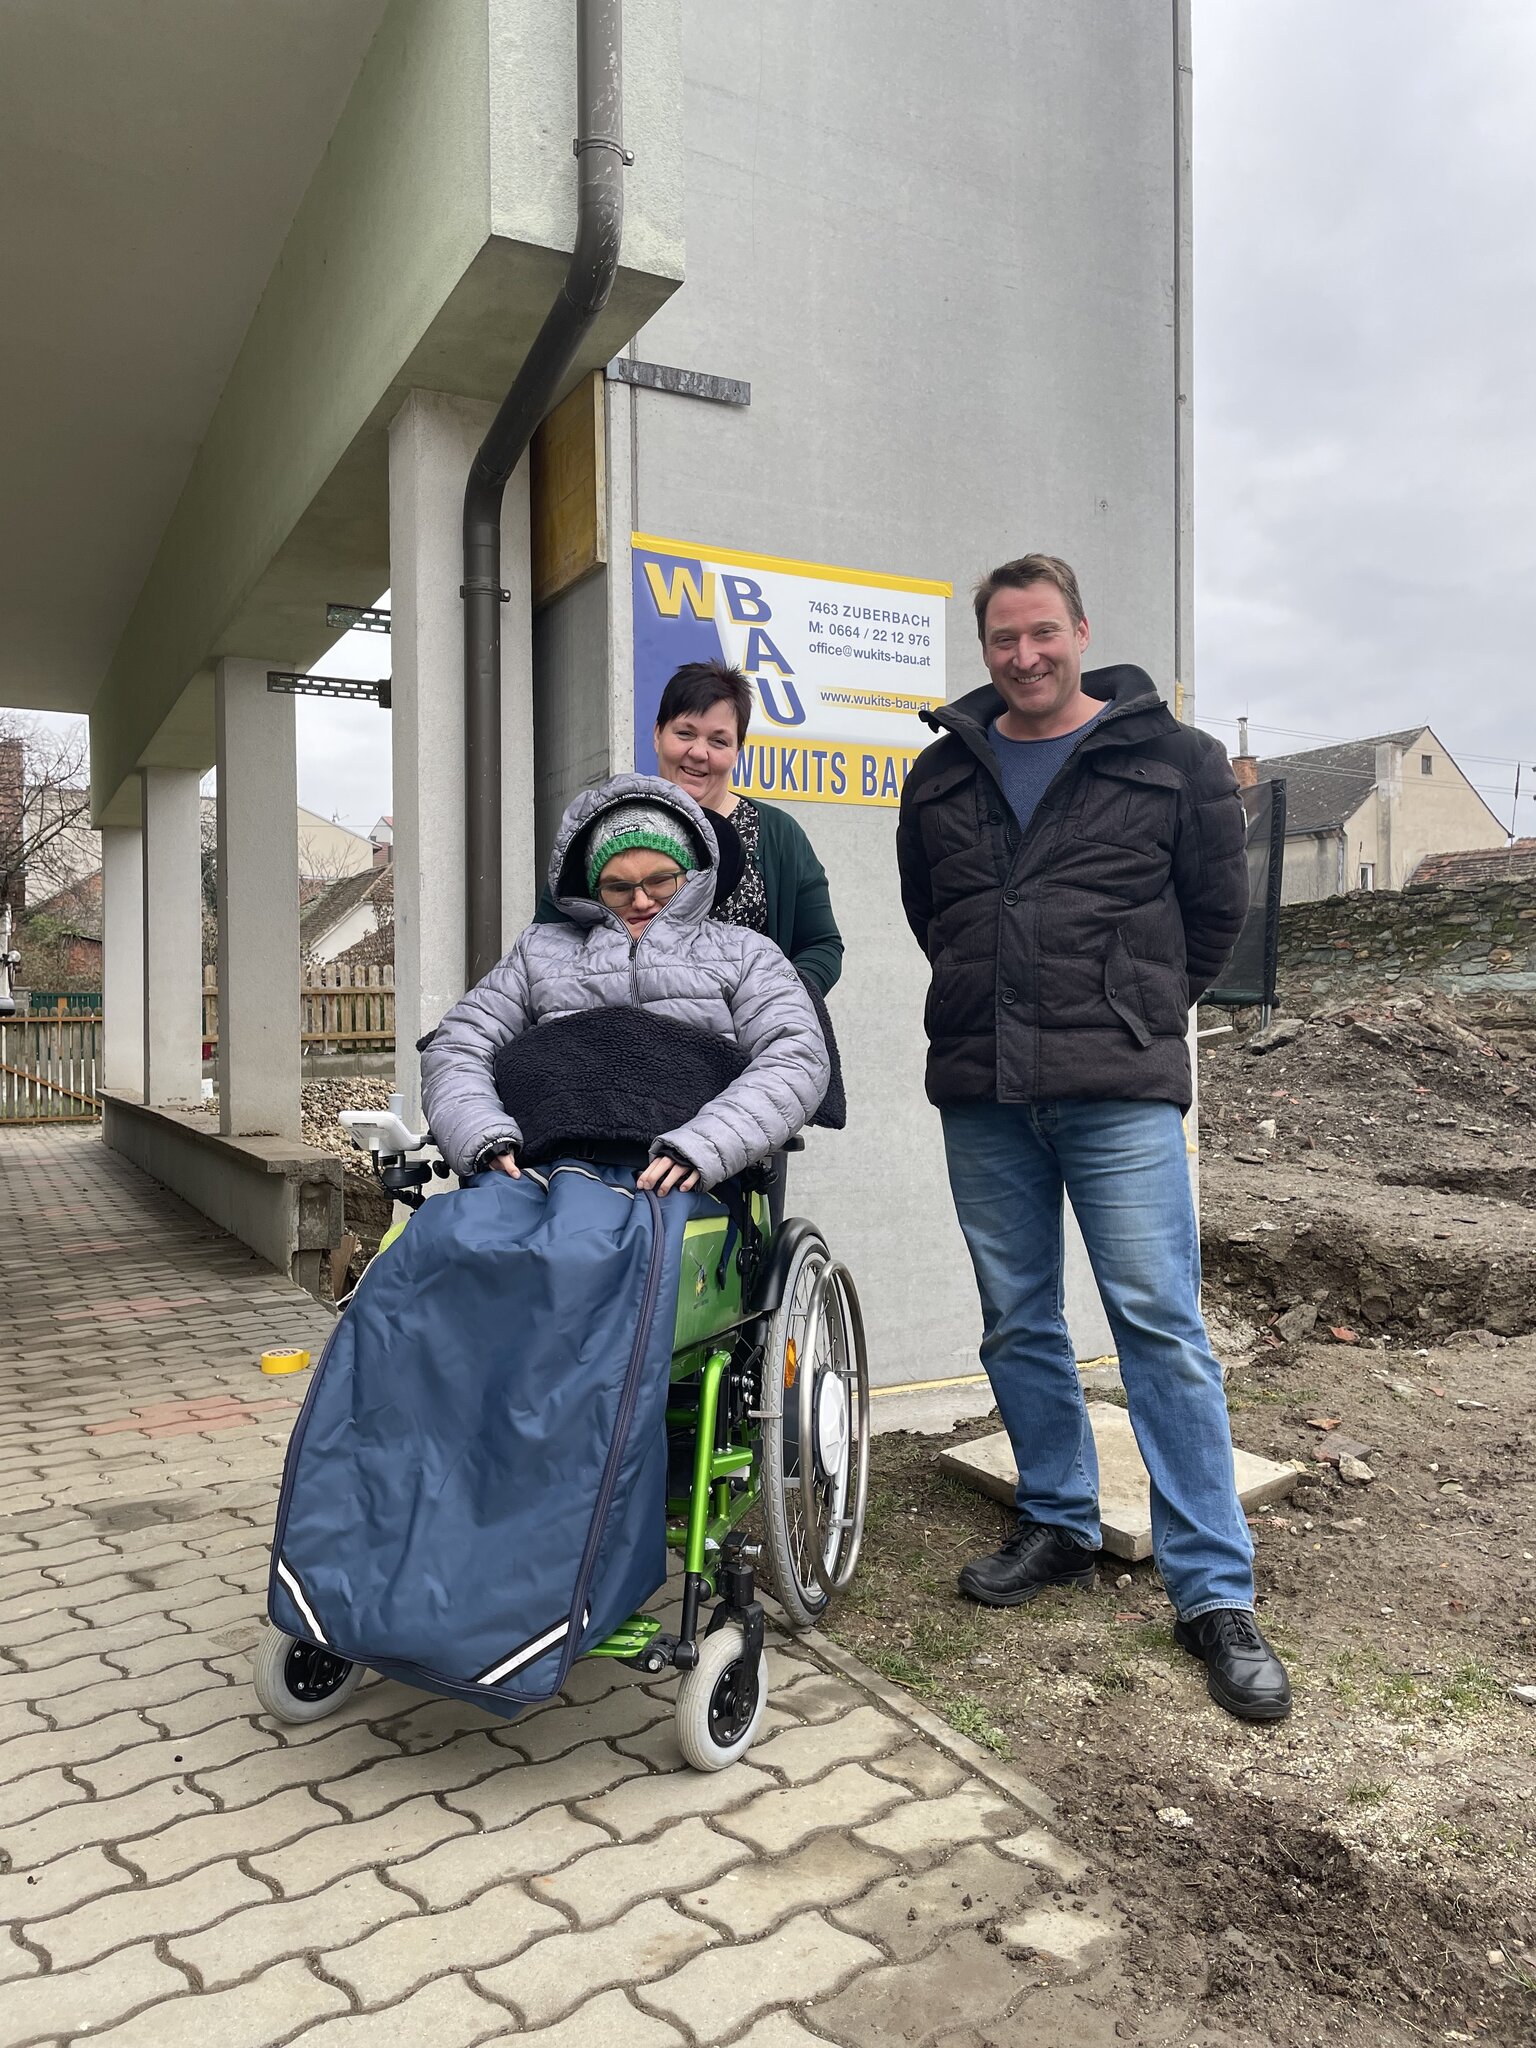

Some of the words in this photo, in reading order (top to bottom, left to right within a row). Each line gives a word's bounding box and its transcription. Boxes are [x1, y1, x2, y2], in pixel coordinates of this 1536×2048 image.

[643, 562, 716, 621] W
[808, 600, 839, 616] 7463
[842, 605, 930, 628] ZUBERBACH
[808, 620, 824, 634] M:
[828, 623, 860, 639] 0664
[863, 627, 870, 640] /
[872, 629, 888, 642] 22
[890, 631, 905, 644] 12
[908, 633, 931, 647] 976
[720, 574, 806, 728] BAU
[808, 641, 931, 667] office@wukits-bau.at
[820, 691, 931, 711] www.wukits-bau.at
[731, 744, 848, 796] WUKITS
